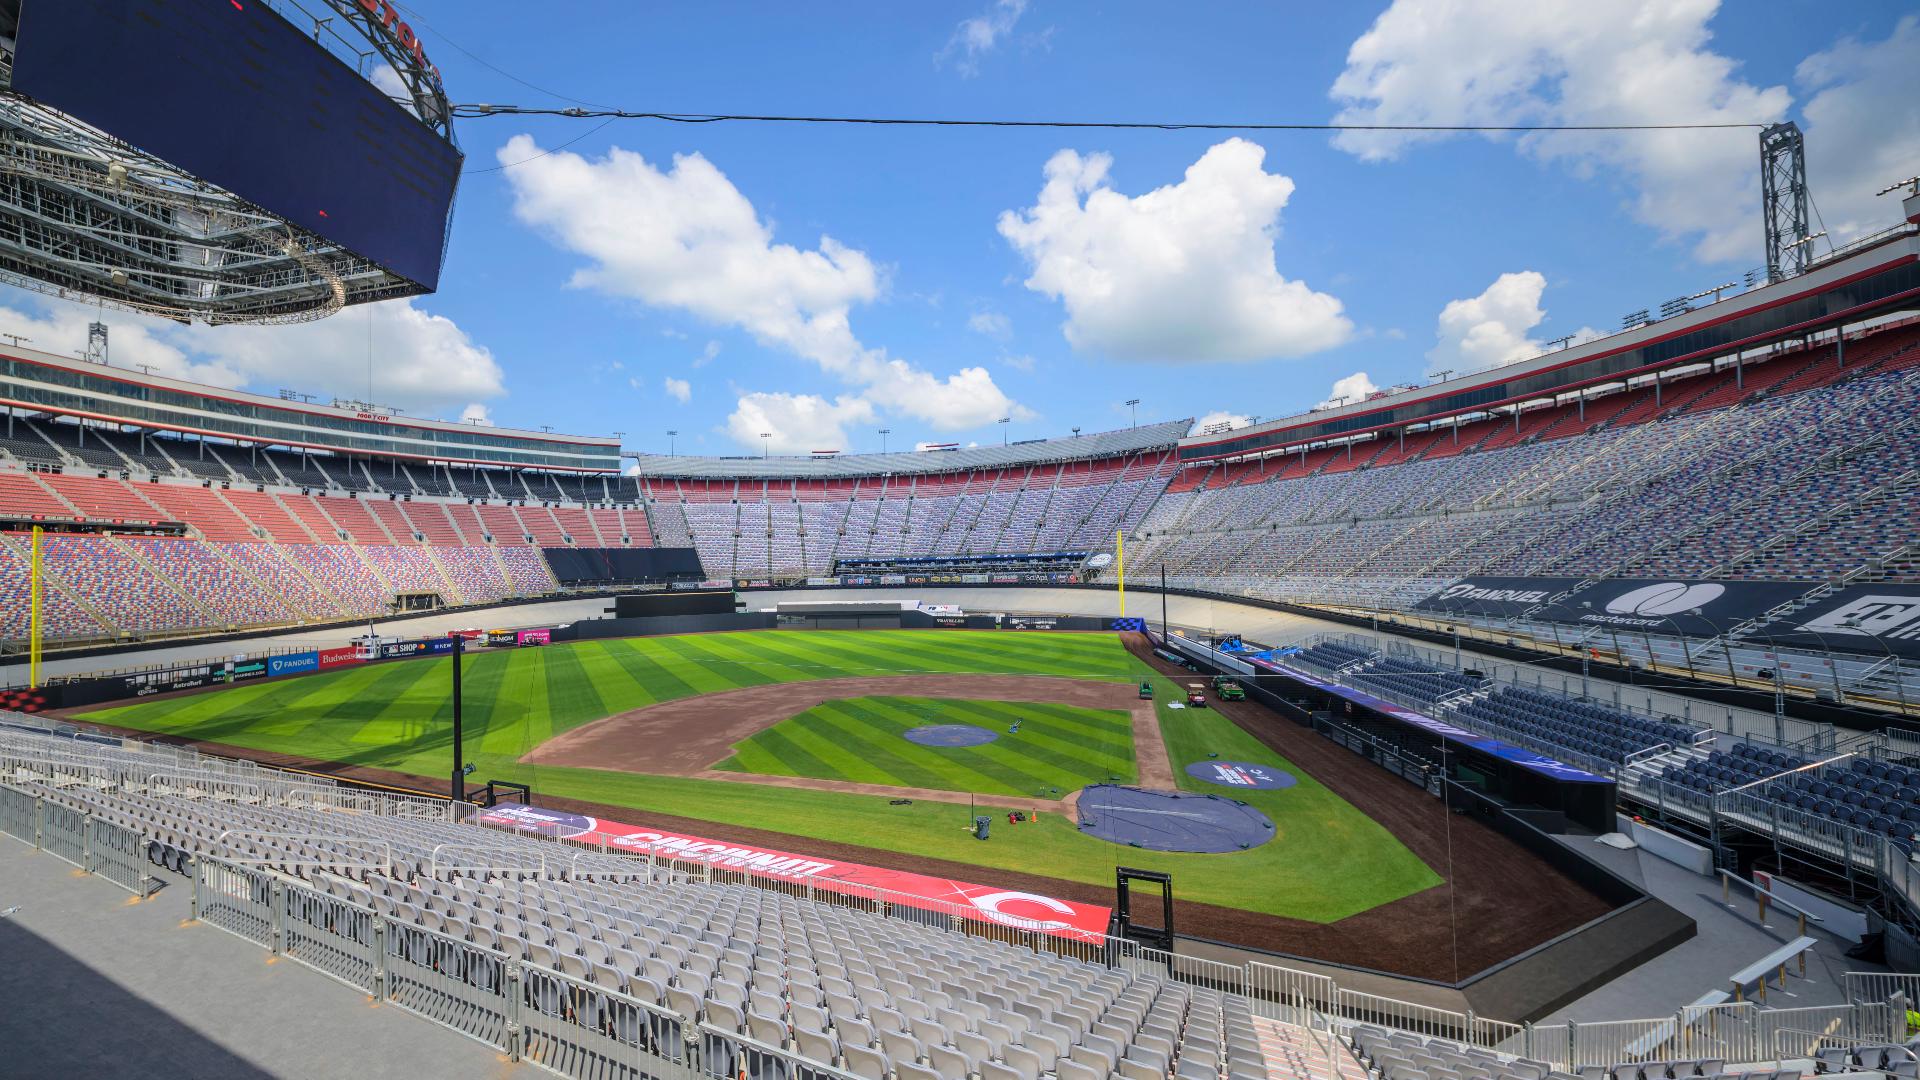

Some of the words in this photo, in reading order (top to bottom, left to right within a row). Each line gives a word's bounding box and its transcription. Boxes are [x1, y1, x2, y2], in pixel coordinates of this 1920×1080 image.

[1462, 588, 1549, 603] FANDUEL
[1579, 613, 1667, 627] mastercard
[399, 643, 418, 653] SHOP
[284, 658, 315, 668] FANDUEL
[322, 652, 359, 664] Budweis
[173, 679, 203, 689] AstroTurf
[612, 832, 835, 879] CINCINNATI
